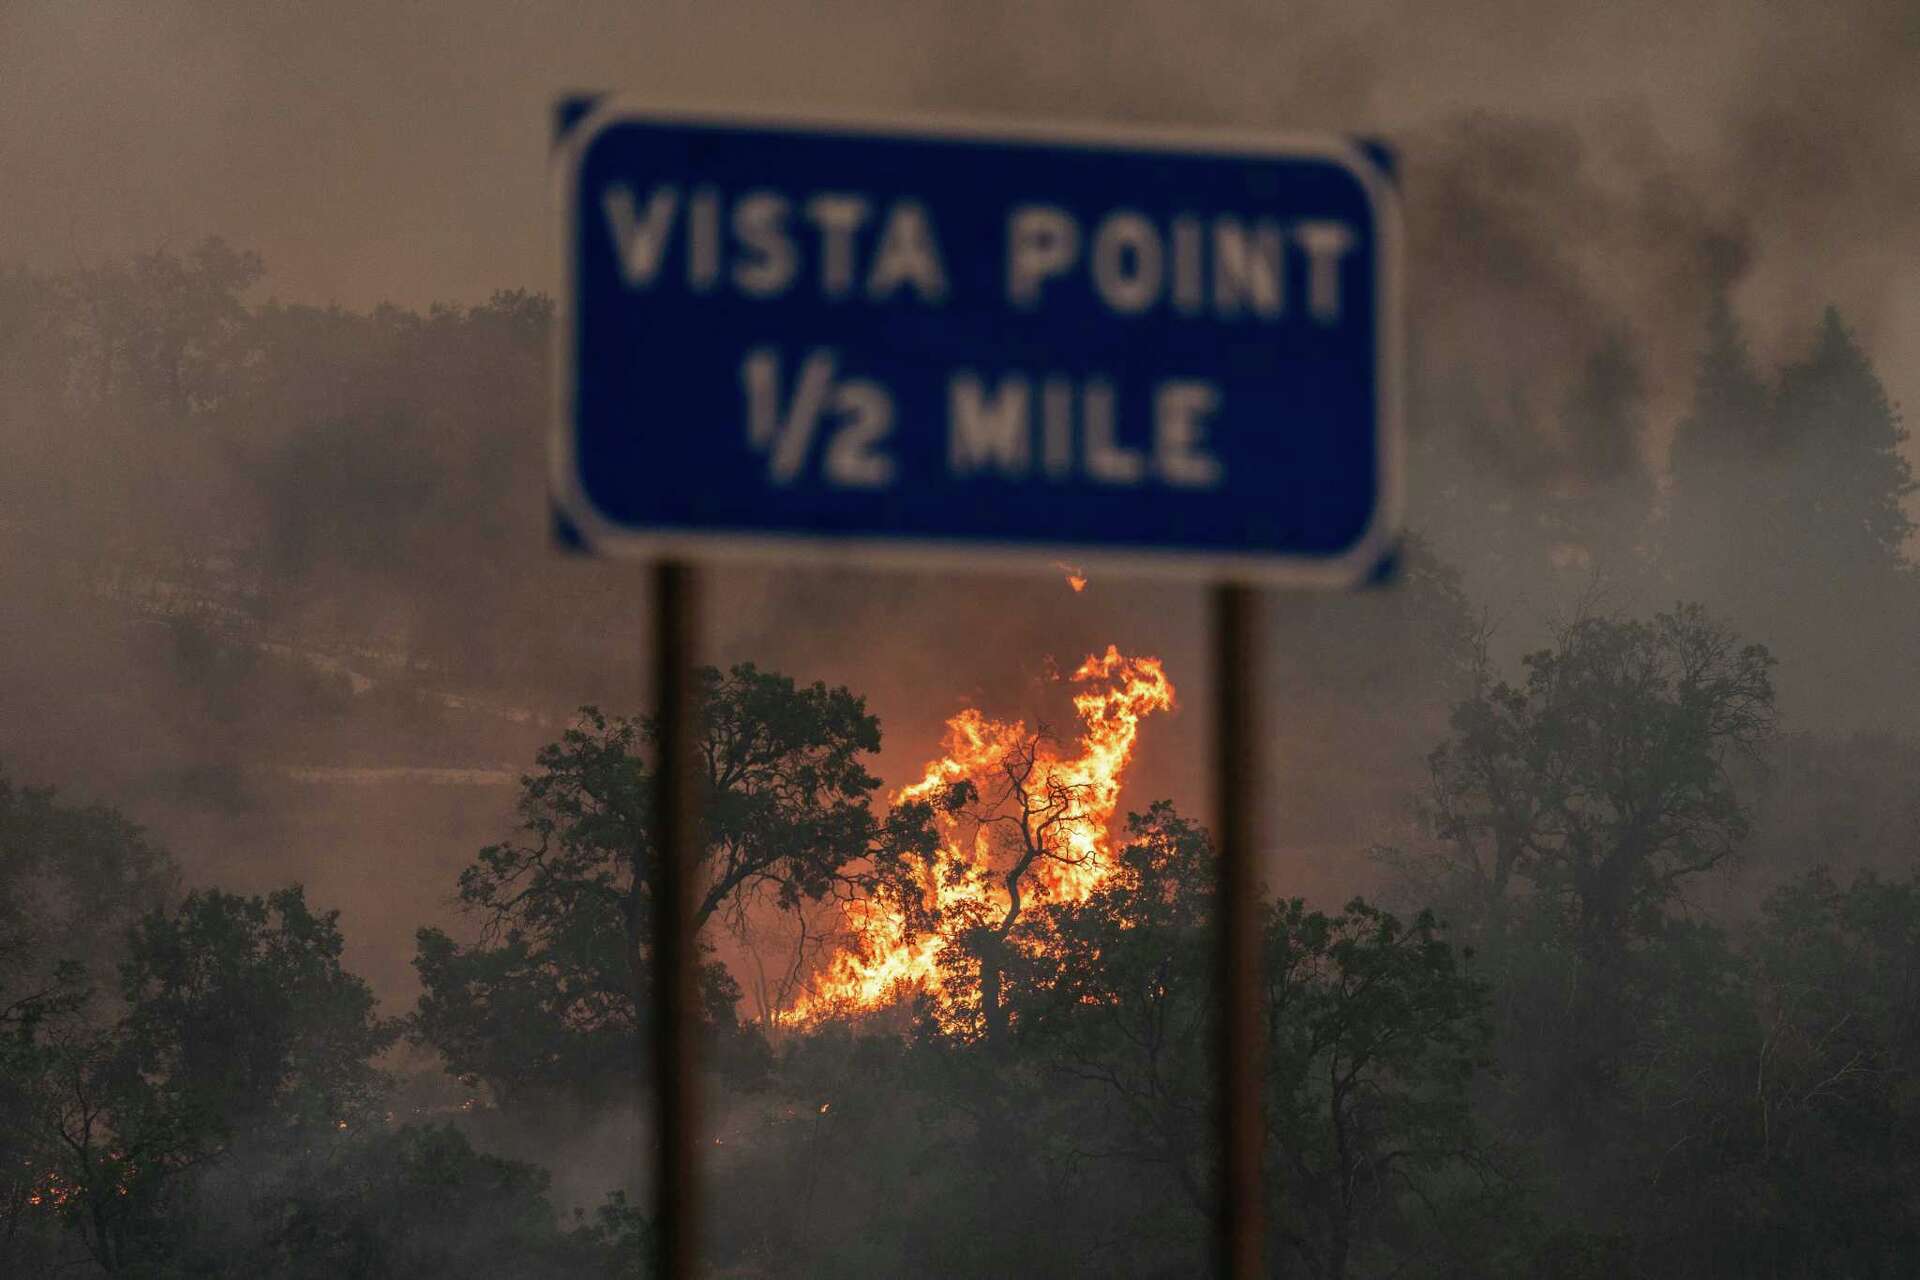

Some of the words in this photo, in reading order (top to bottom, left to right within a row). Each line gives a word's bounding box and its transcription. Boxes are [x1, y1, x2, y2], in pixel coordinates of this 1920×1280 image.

[605, 185, 948, 301] VISTA
[1009, 204, 1354, 322] POINT
[743, 350, 895, 486] 1/2
[950, 373, 1222, 487] MILE
